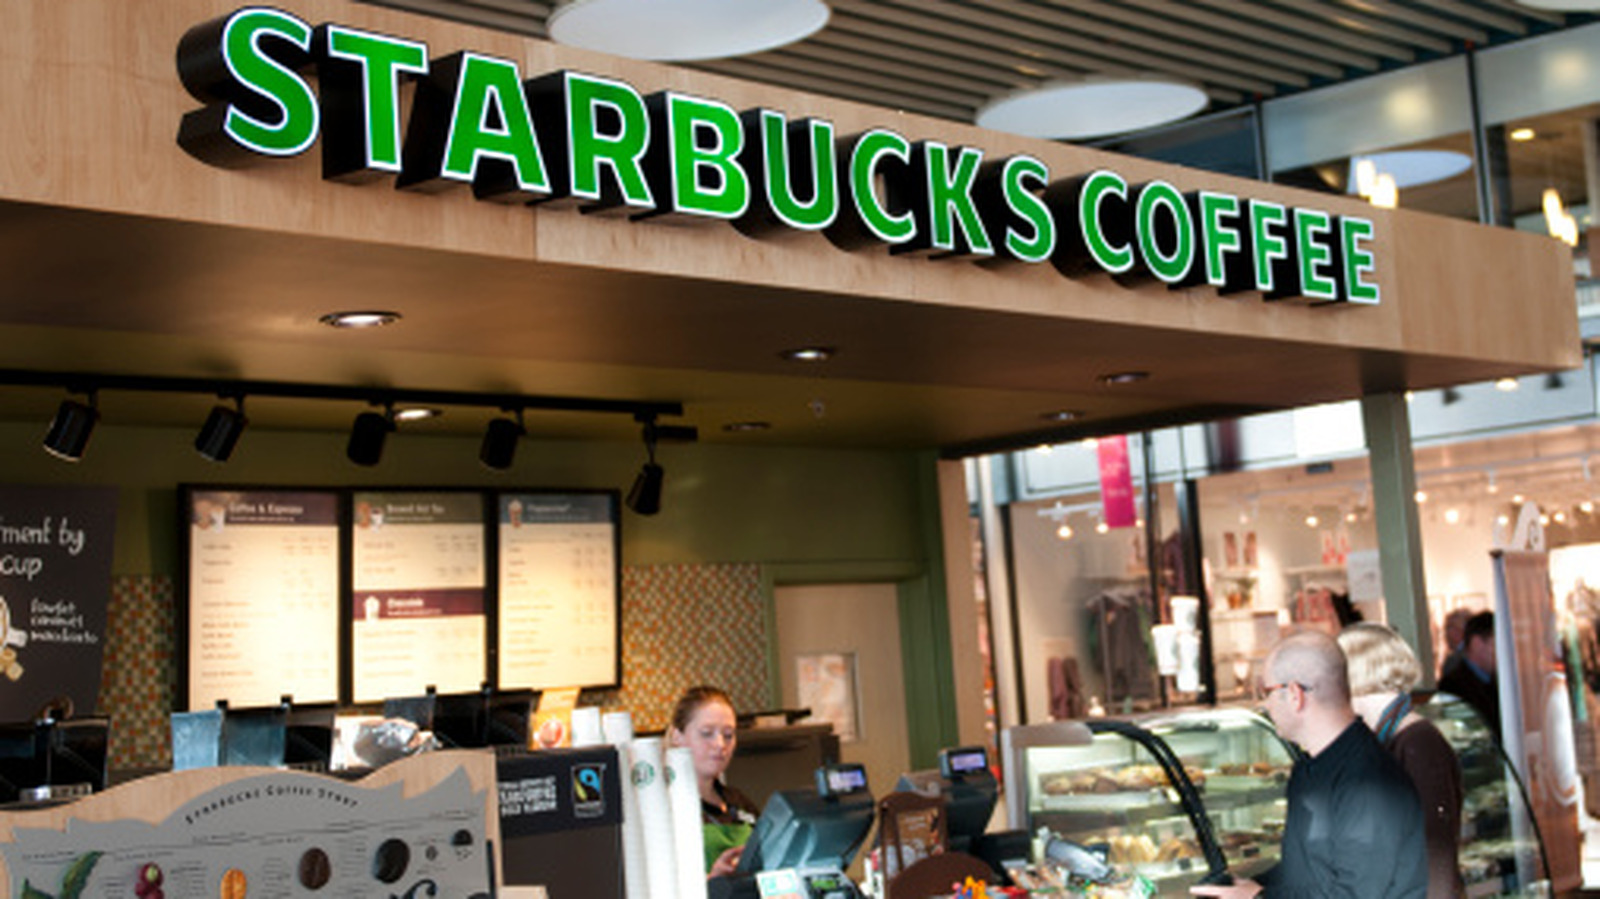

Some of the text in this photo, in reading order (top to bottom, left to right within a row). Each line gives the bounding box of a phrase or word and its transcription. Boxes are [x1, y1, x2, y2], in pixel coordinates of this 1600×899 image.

[221, 7, 1381, 304] STARBUCKS COFFEE
[59, 517, 85, 556] by
[0, 554, 42, 581] cup
